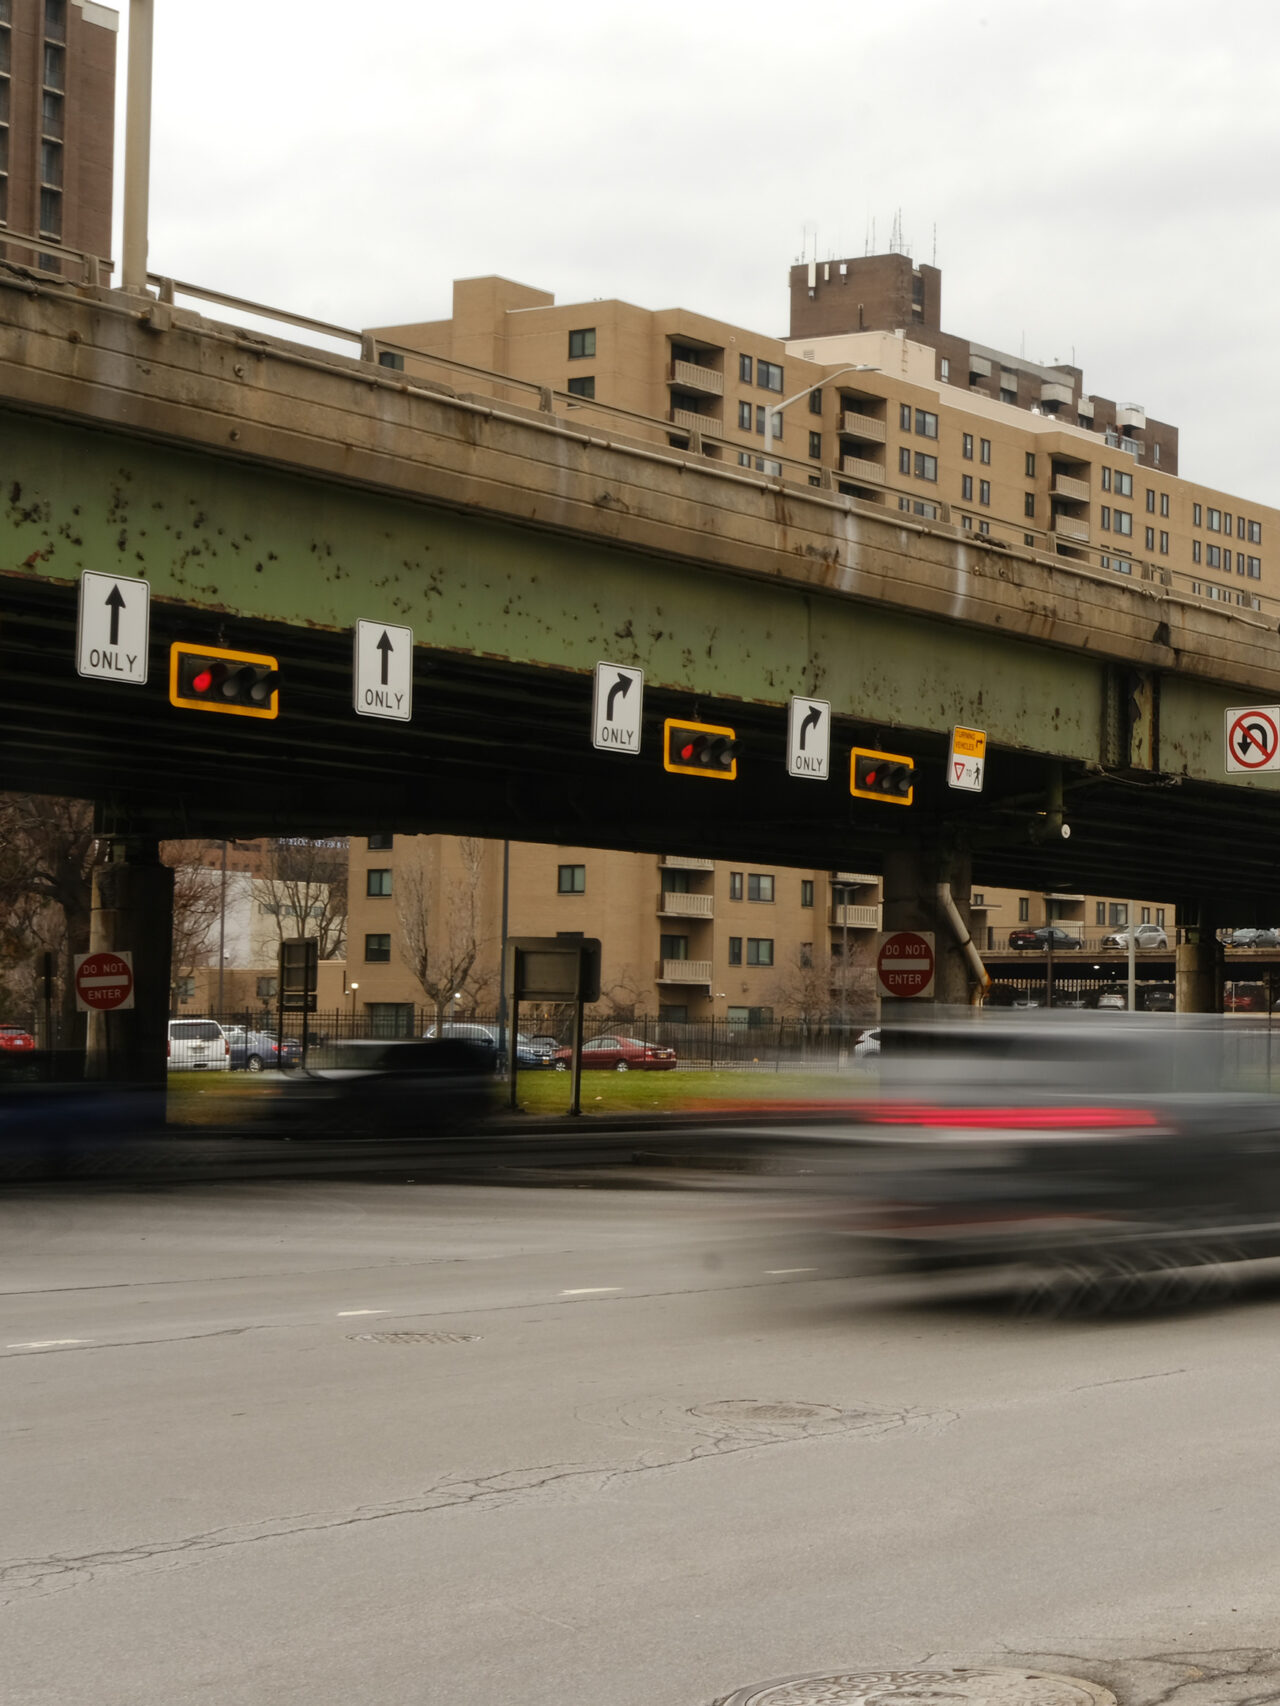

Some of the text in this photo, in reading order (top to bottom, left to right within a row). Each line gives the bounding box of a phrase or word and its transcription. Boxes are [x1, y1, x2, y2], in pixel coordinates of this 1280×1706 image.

[89, 648, 138, 673] ONLY
[364, 688, 404, 711] ONLY
[601, 726, 634, 746] ONLY
[795, 755, 823, 772] ONLY
[885, 944, 926, 955] DO NOT
[82, 963, 124, 974] DO NOT
[889, 974, 922, 984] ENTER
[88, 989, 121, 1000] ENTER
